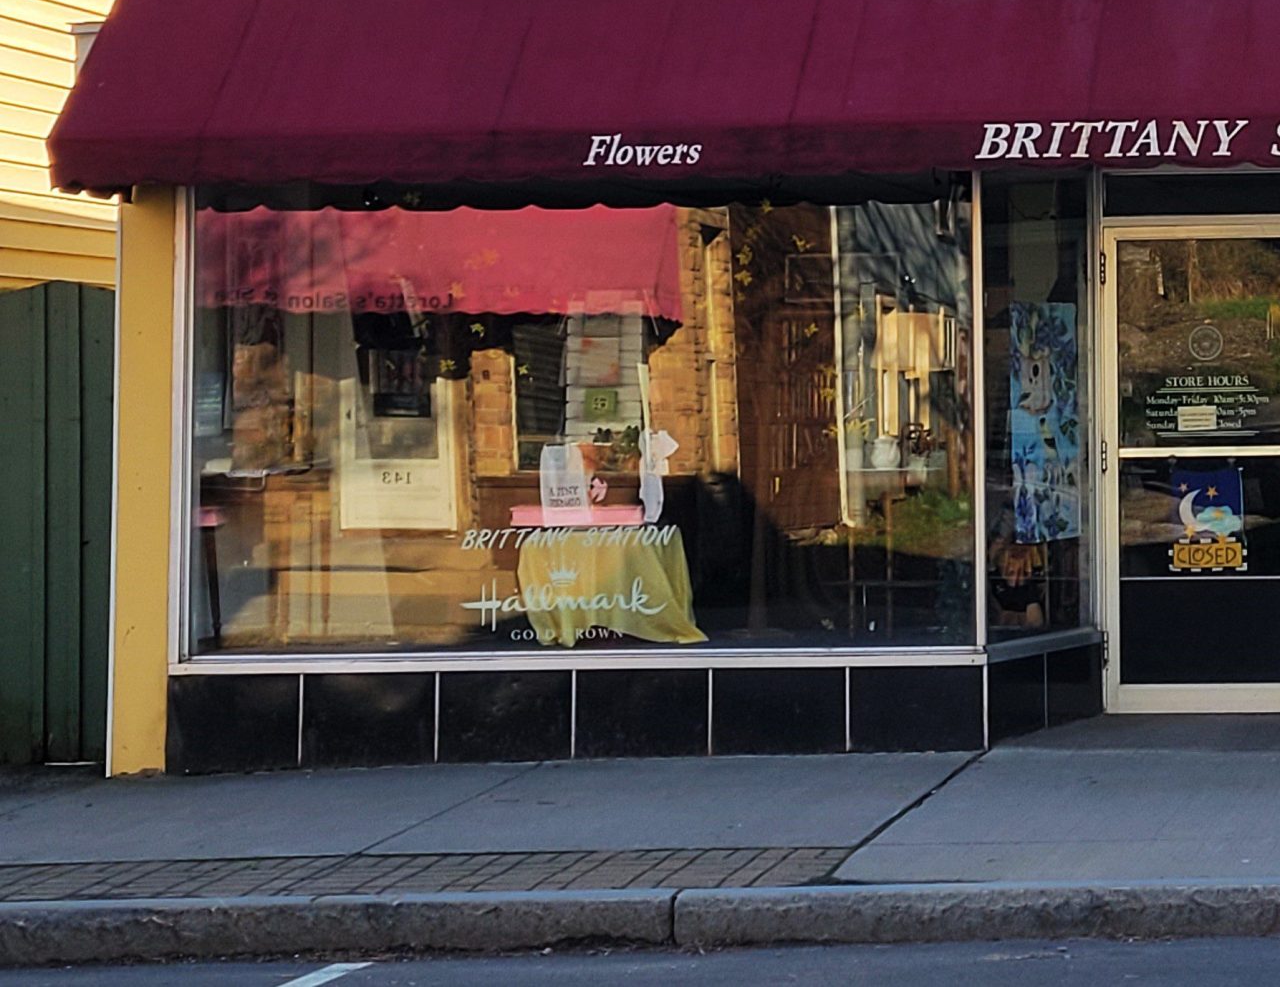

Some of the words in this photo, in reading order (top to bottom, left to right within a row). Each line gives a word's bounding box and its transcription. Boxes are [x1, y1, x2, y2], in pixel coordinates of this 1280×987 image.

[583, 133, 702, 166] Flowers
[975, 119, 1249, 160] BRITTANY
[1165, 376, 1203, 387] STORE
[1208, 375, 1249, 387] HOURS
[1146, 407, 1178, 417] Saturda
[1216, 407, 1257, 418] 0am-5pm
[1146, 420, 1176, 431] Sunday
[461, 526, 571, 551] BRITTANY
[583, 525, 679, 547] STATION
[1176, 545, 1237, 566] CLOSED
[459, 578, 668, 632] Hallmark
[564, 628, 624, 641] ROWN
